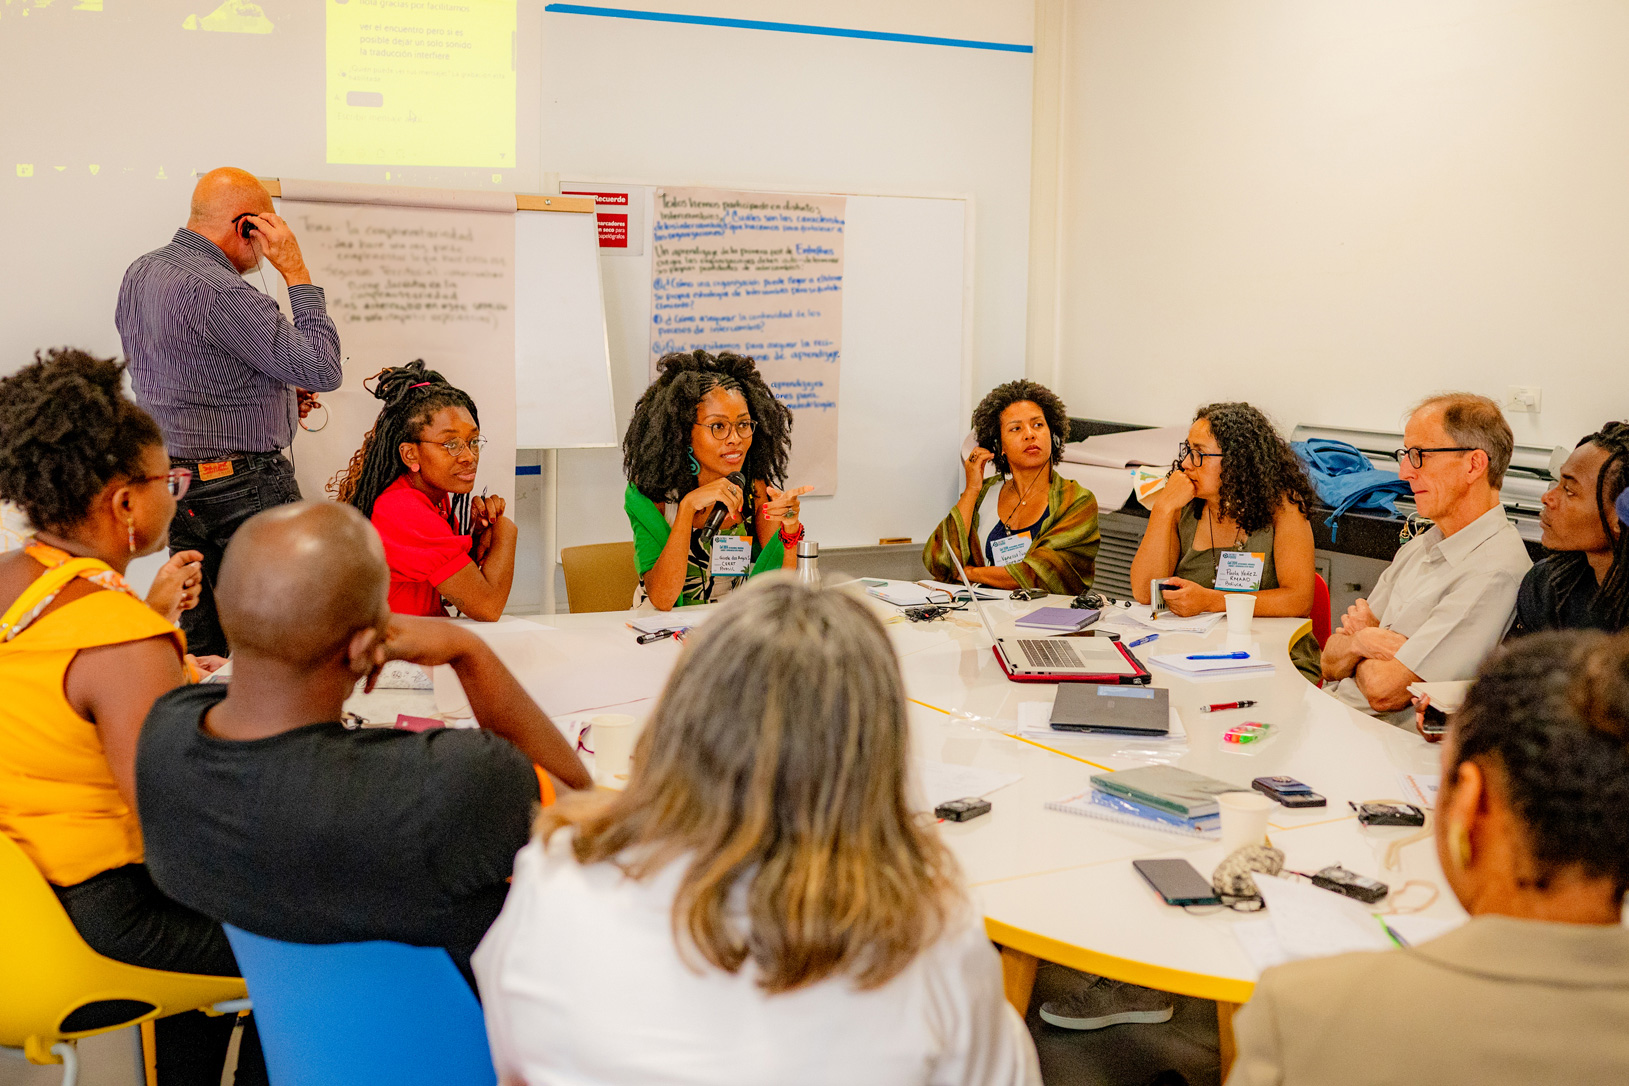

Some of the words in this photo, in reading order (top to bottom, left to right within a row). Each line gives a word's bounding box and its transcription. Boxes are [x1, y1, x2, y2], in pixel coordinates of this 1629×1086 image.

[411, 2, 425, 11] por
[384, 25, 424, 34] encuentro
[426, 28, 445, 37] pero
[360, 36, 390, 45] posible
[392, 37, 413, 47] dejar
[446, 41, 472, 49] sonido
[359, 48, 368, 56] la
[370, 49, 413, 58] traducción
[414, 51, 450, 60] interfiere
